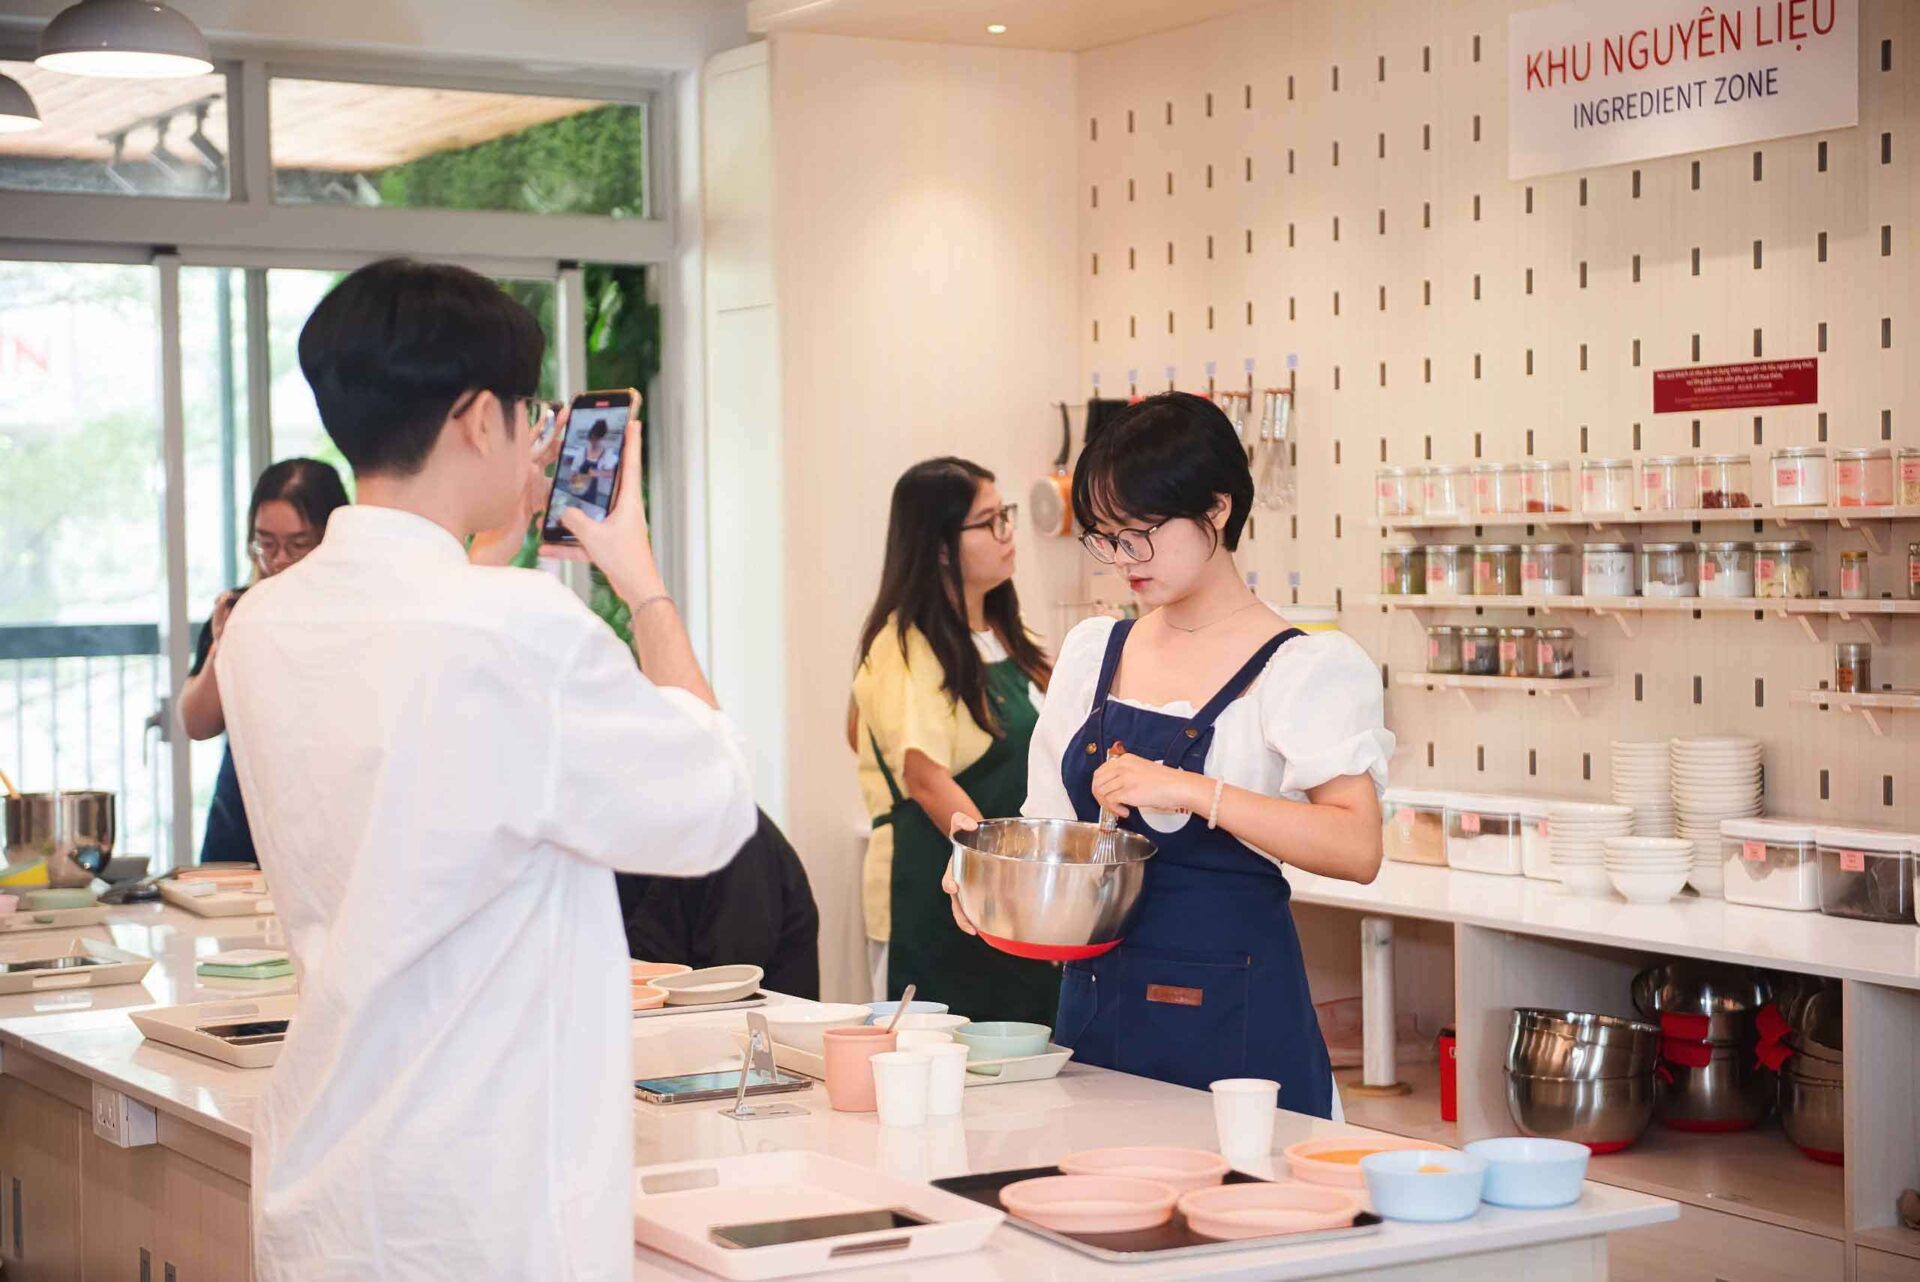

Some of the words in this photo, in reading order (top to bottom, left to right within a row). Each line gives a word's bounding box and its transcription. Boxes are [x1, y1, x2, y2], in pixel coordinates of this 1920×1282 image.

[1526, 42, 1591, 91] KHU
[1603, 6, 1741, 76] NGUYÊN
[1573, 81, 1707, 129] INGREDIENT
[1714, 67, 1778, 105] ZONE
